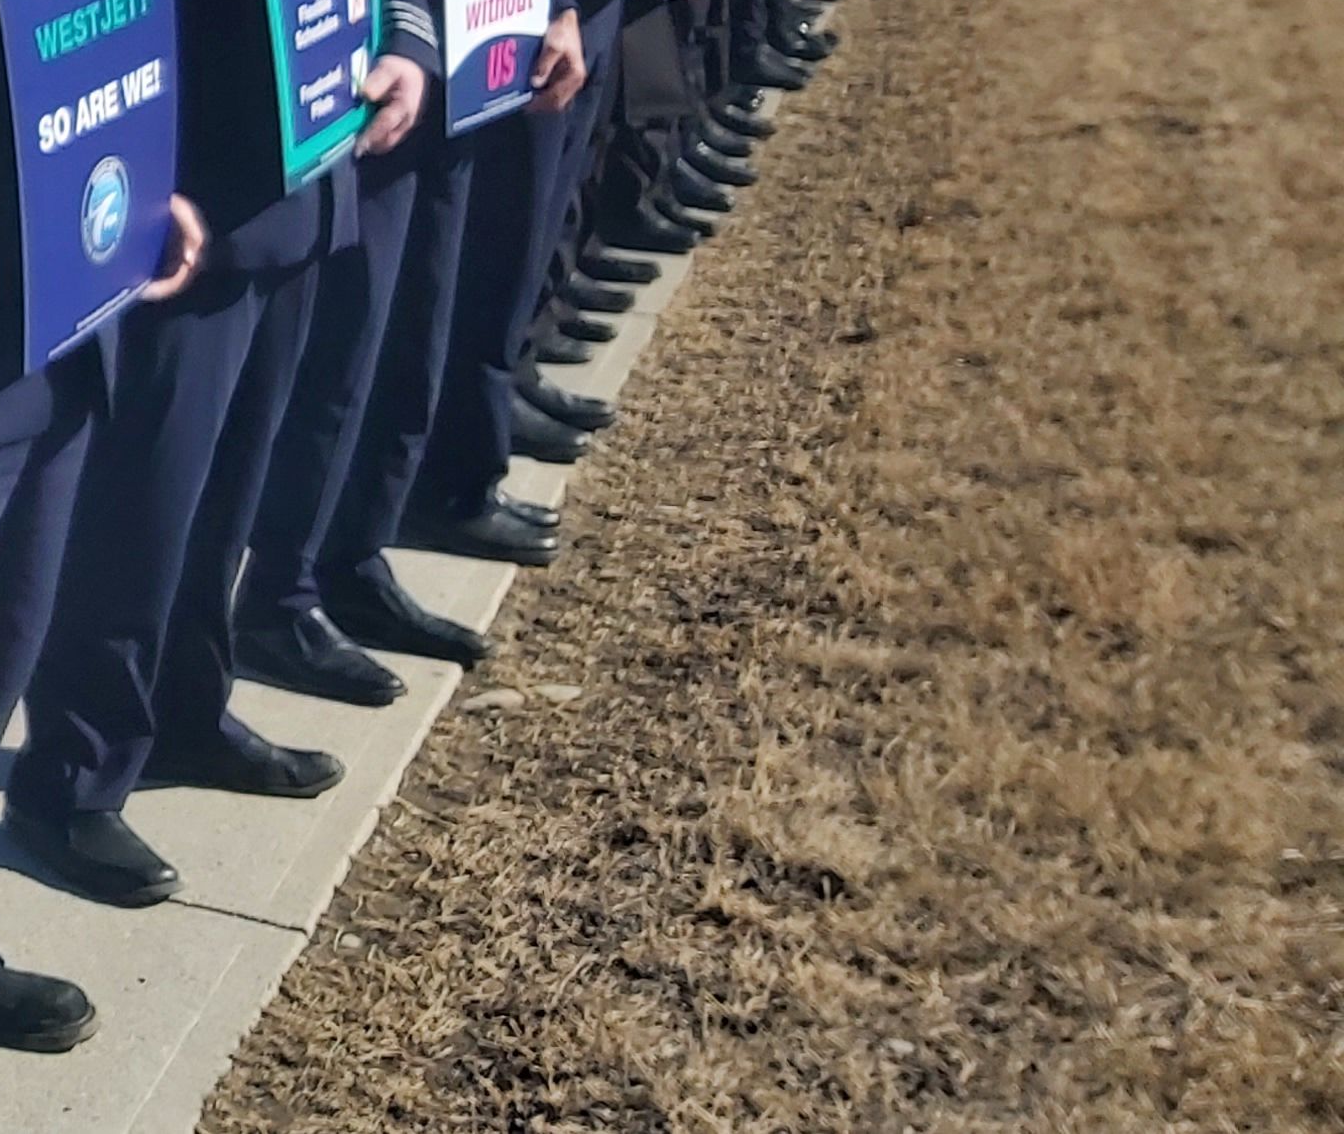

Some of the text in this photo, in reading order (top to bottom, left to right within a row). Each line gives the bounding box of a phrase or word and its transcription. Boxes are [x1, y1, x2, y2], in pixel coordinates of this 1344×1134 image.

[487, 38, 518, 92] US
[38, 58, 163, 154] SO ARE WE!
